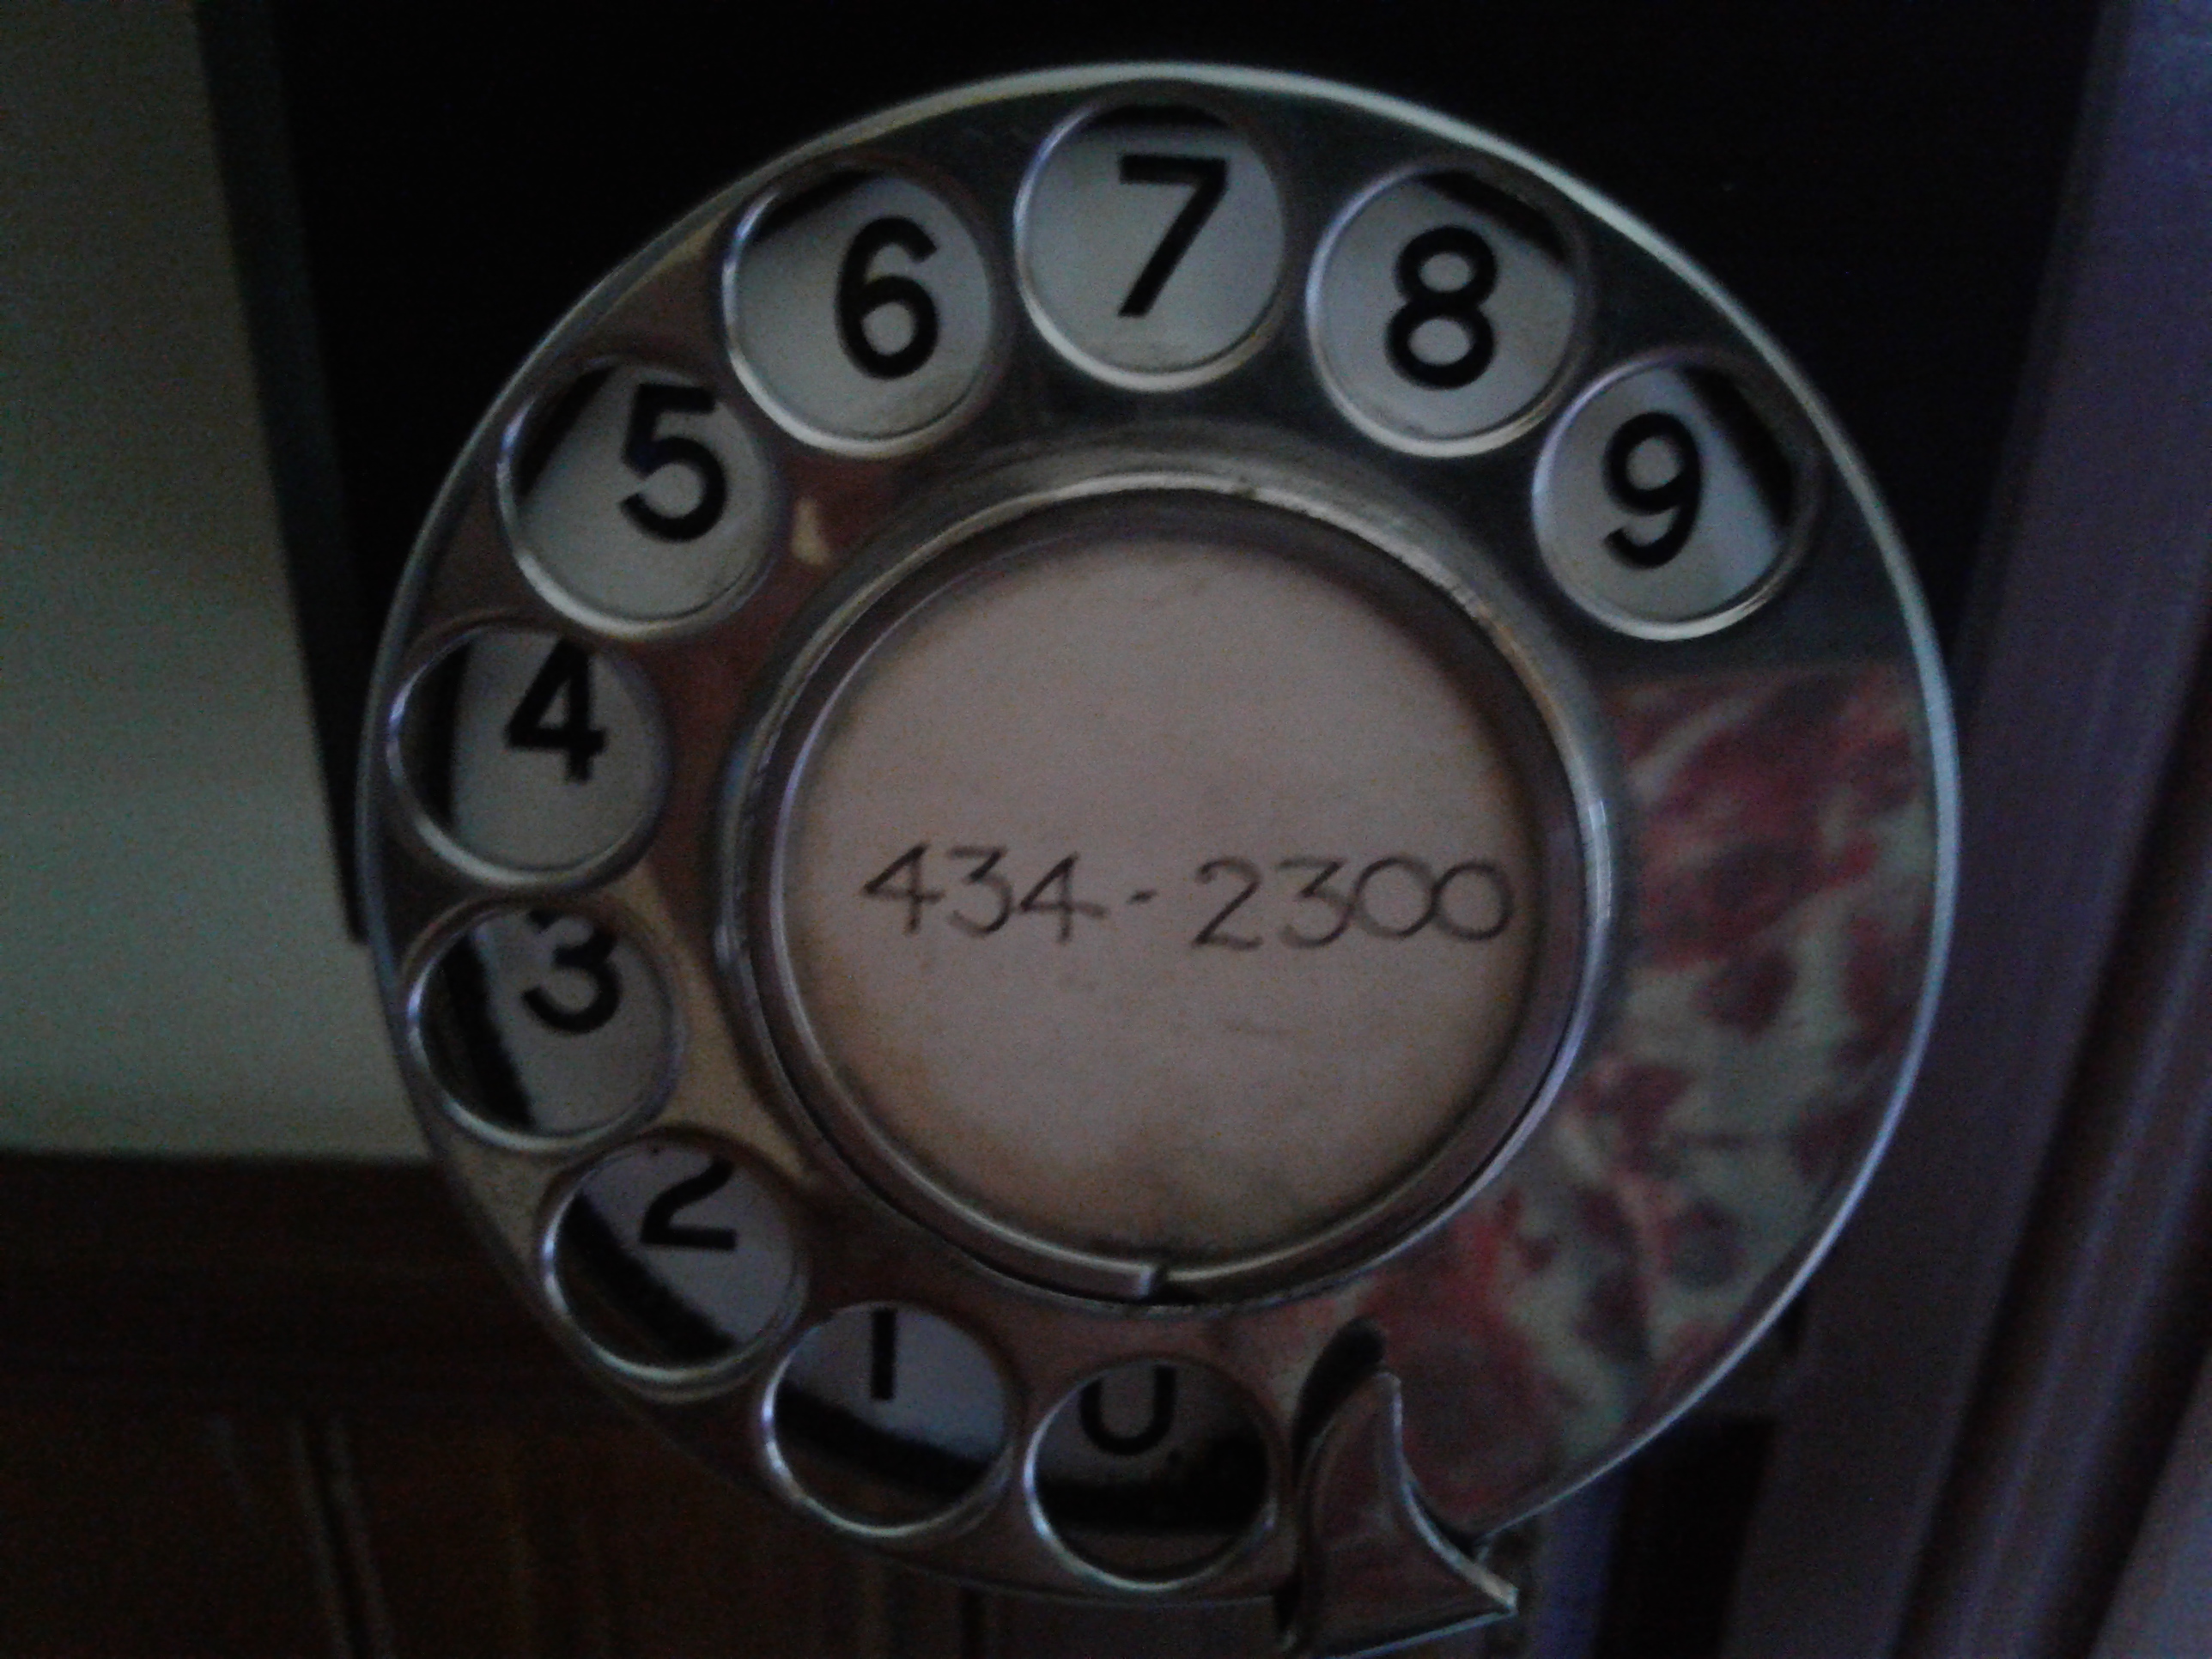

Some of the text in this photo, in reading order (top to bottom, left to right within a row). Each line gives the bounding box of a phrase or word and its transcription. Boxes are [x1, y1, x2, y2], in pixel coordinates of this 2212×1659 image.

[834, 216, 939, 380] 6
[1119, 154, 1226, 317] 7
[1387, 226, 1497, 388] 8
[620, 383, 726, 542] 5
[1603, 410, 1704, 569] 9
[506, 637, 609, 783] 4
[522, 910, 621, 1032] 3
